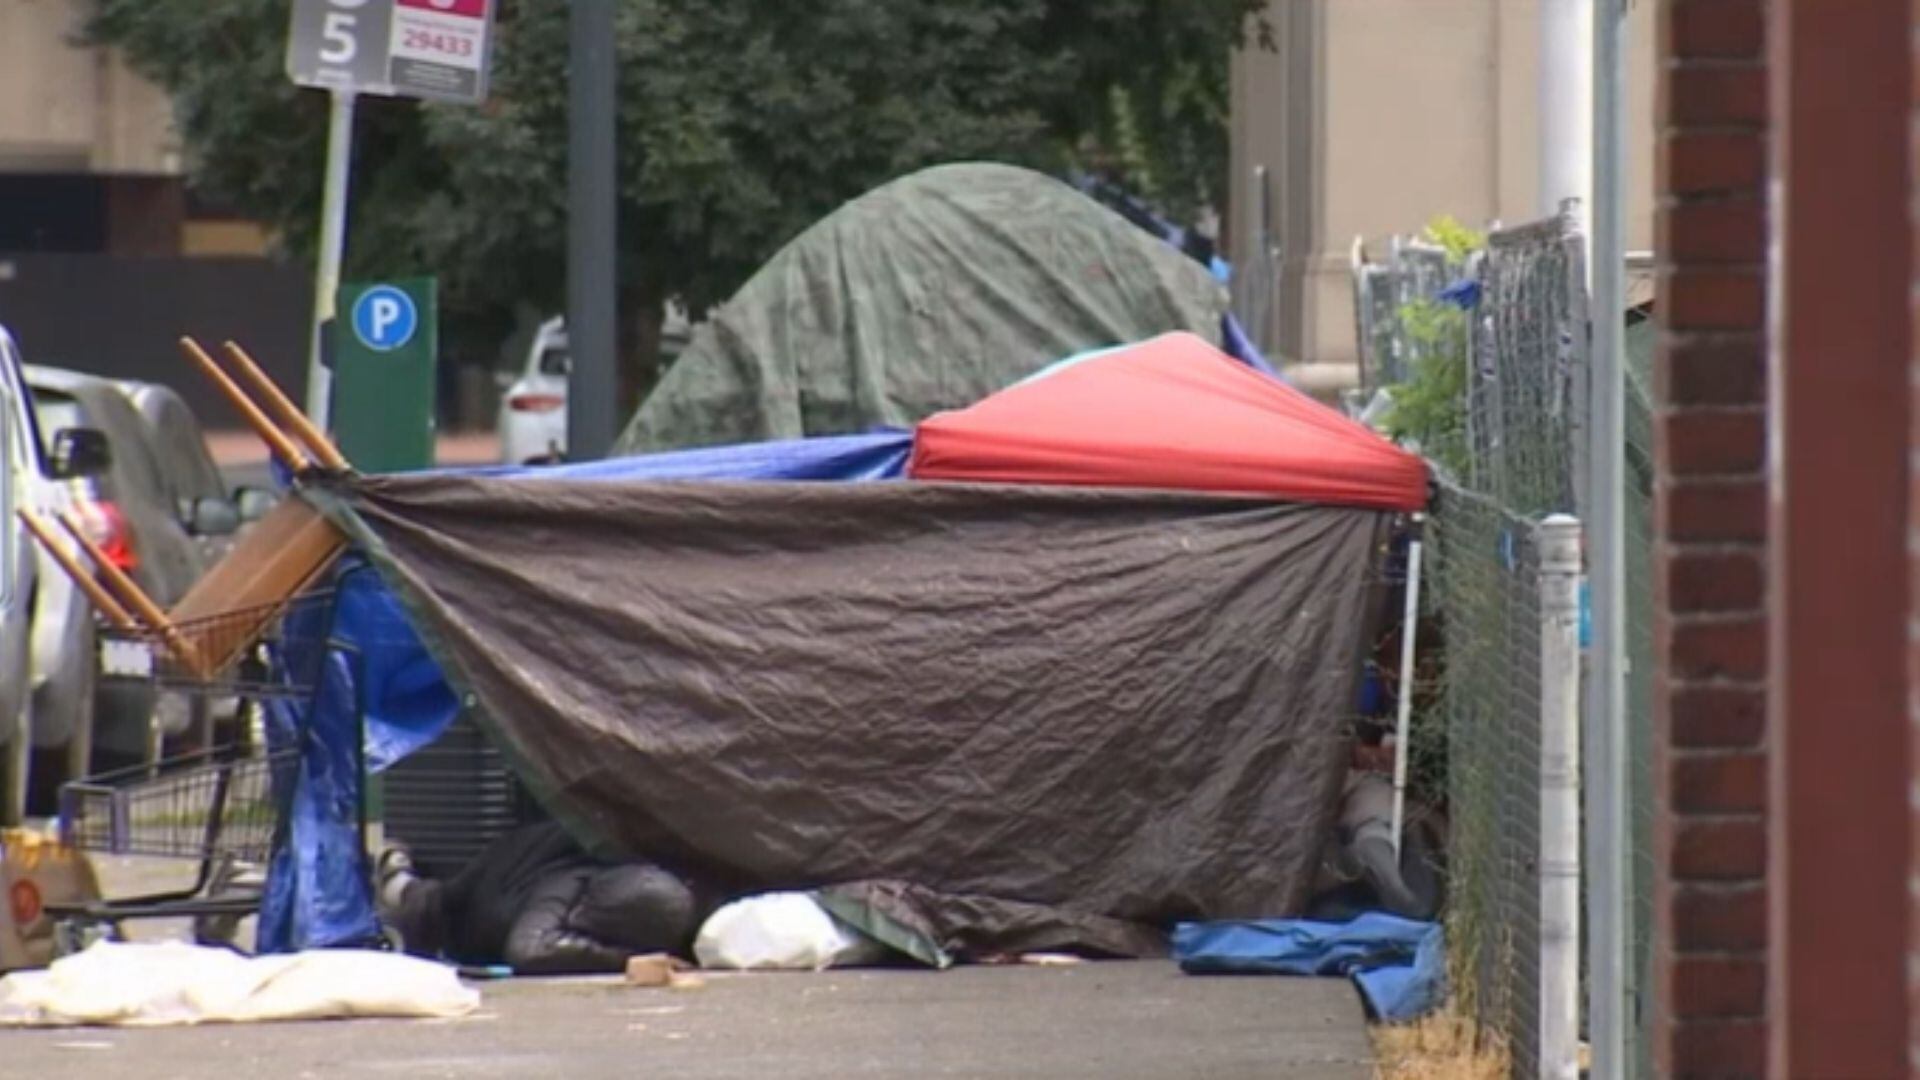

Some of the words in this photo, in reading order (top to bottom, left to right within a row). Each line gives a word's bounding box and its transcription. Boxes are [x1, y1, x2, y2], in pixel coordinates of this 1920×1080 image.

[320, 12, 357, 63] 5
[403, 30, 473, 57] 29433
[372, 297, 399, 341] P
